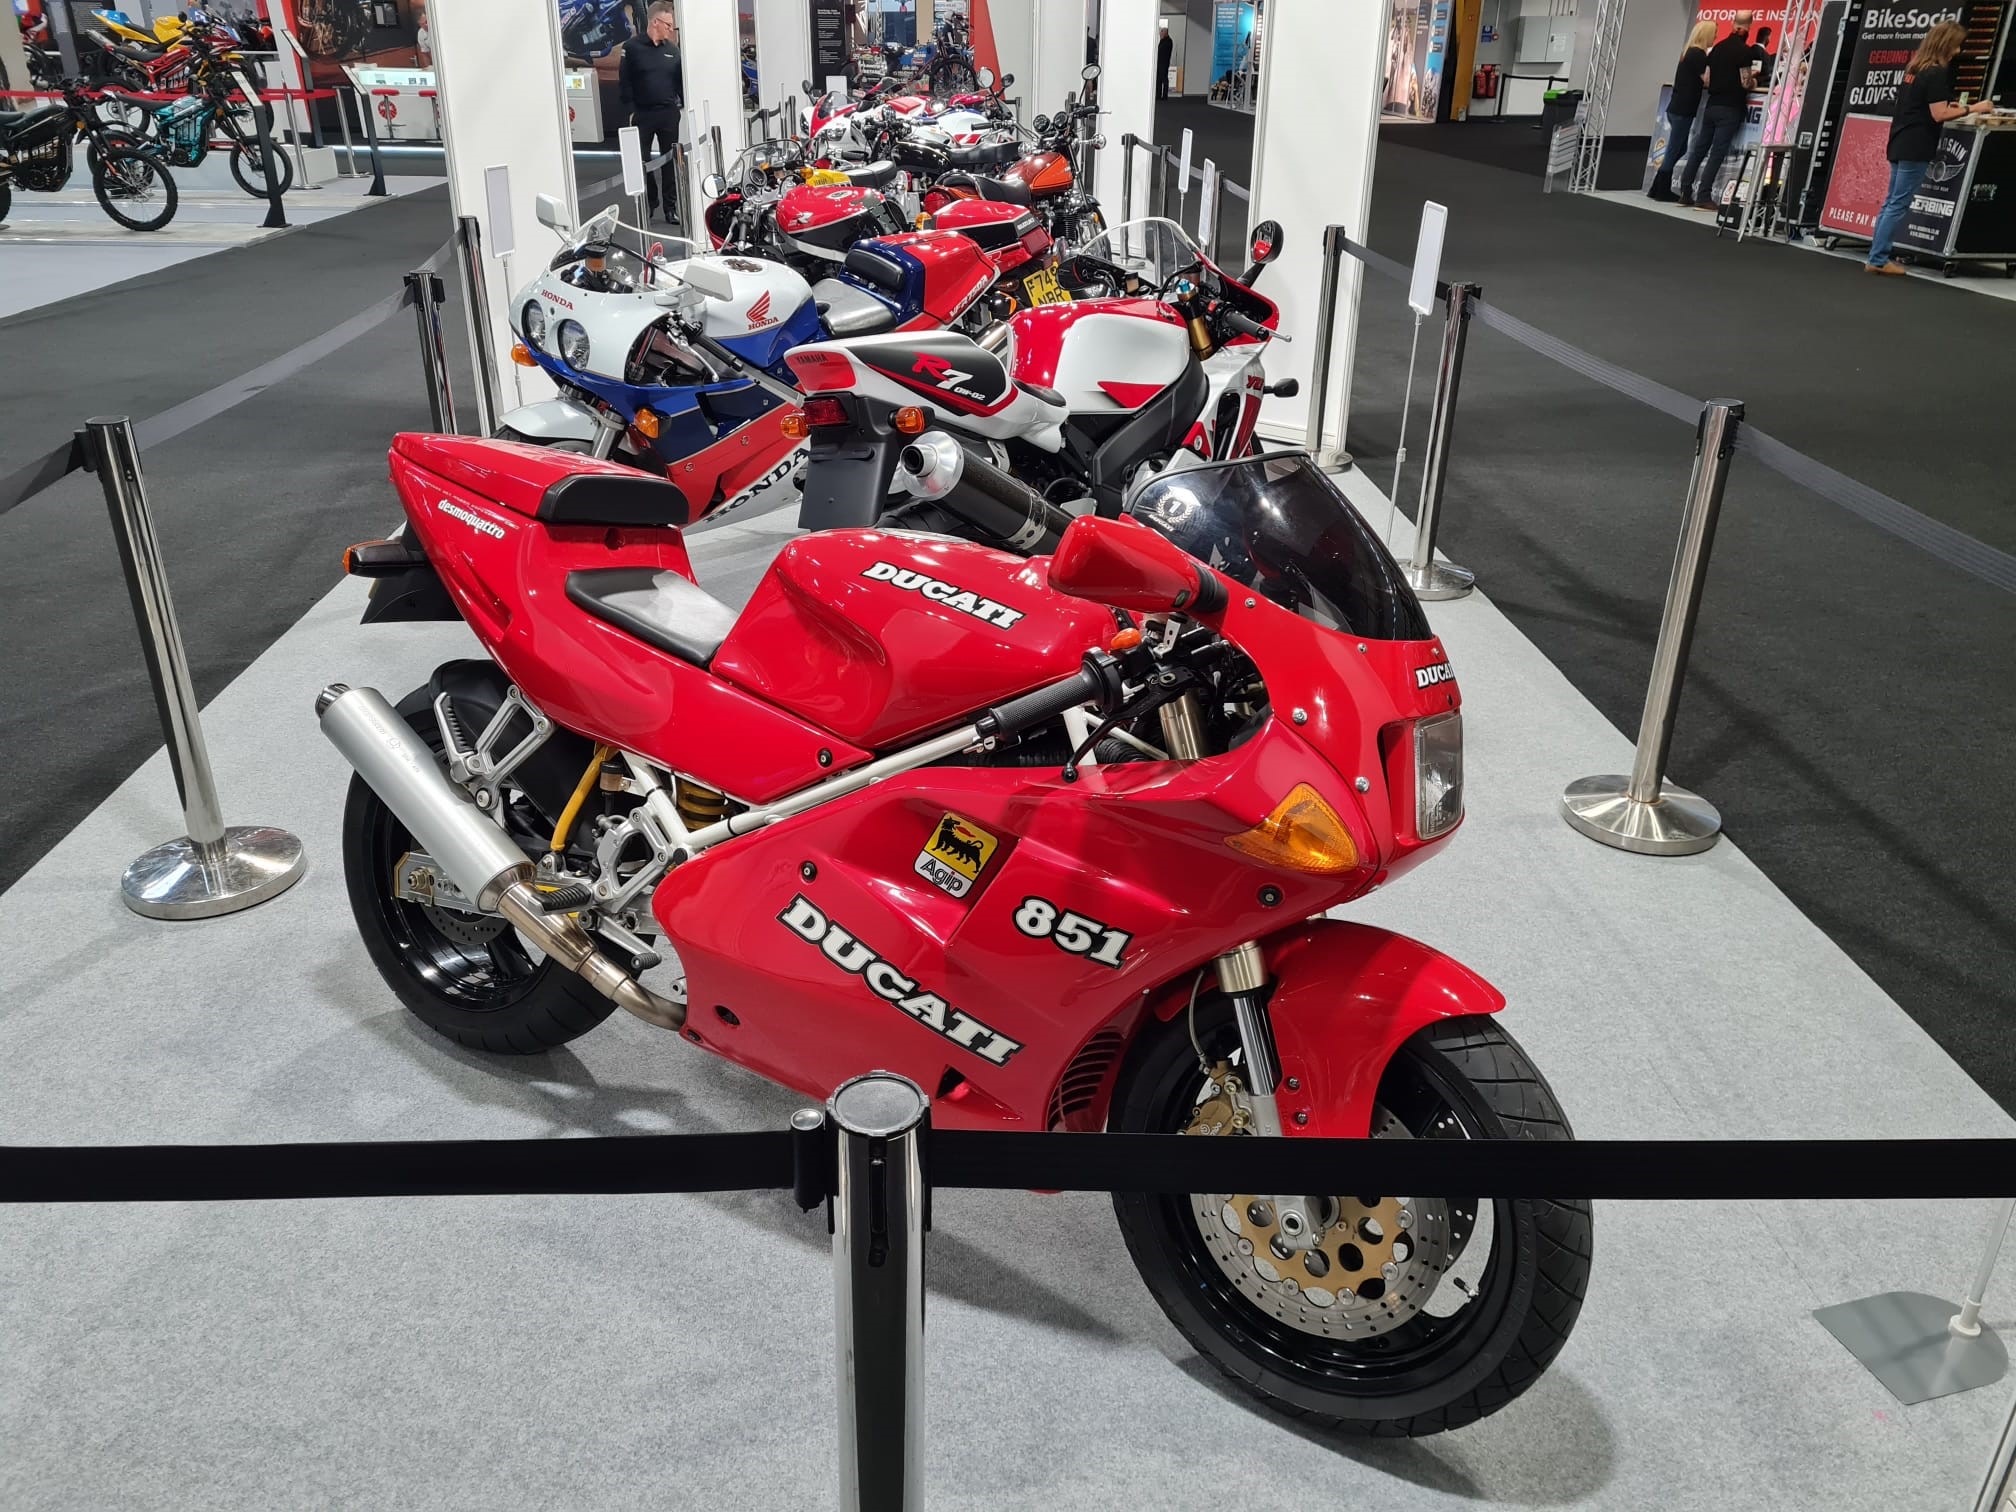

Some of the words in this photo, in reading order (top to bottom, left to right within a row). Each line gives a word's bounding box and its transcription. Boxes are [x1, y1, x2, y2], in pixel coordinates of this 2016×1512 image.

[1864, 8, 1962, 28] BikeSocial
[1862, 32, 1875, 40] Get
[1866, 70, 1892, 86] BEST
[1829, 207, 1854, 223] PLEASE
[1856, 213, 1869, 225] PAY
[541, 289, 574, 311] HONDA
[748, 316, 779, 331] HONDA
[795, 353, 829, 365] YAMAHA
[703, 447, 809, 523] HONDA
[438, 499, 505, 539] desmoquattro
[862, 562, 1026, 630] DUCATI
[1415, 662, 1454, 689] DUCA
[920, 858, 963, 891] Agip
[1013, 896, 1132, 968] 851
[777, 894, 1025, 1067] DUCATI
